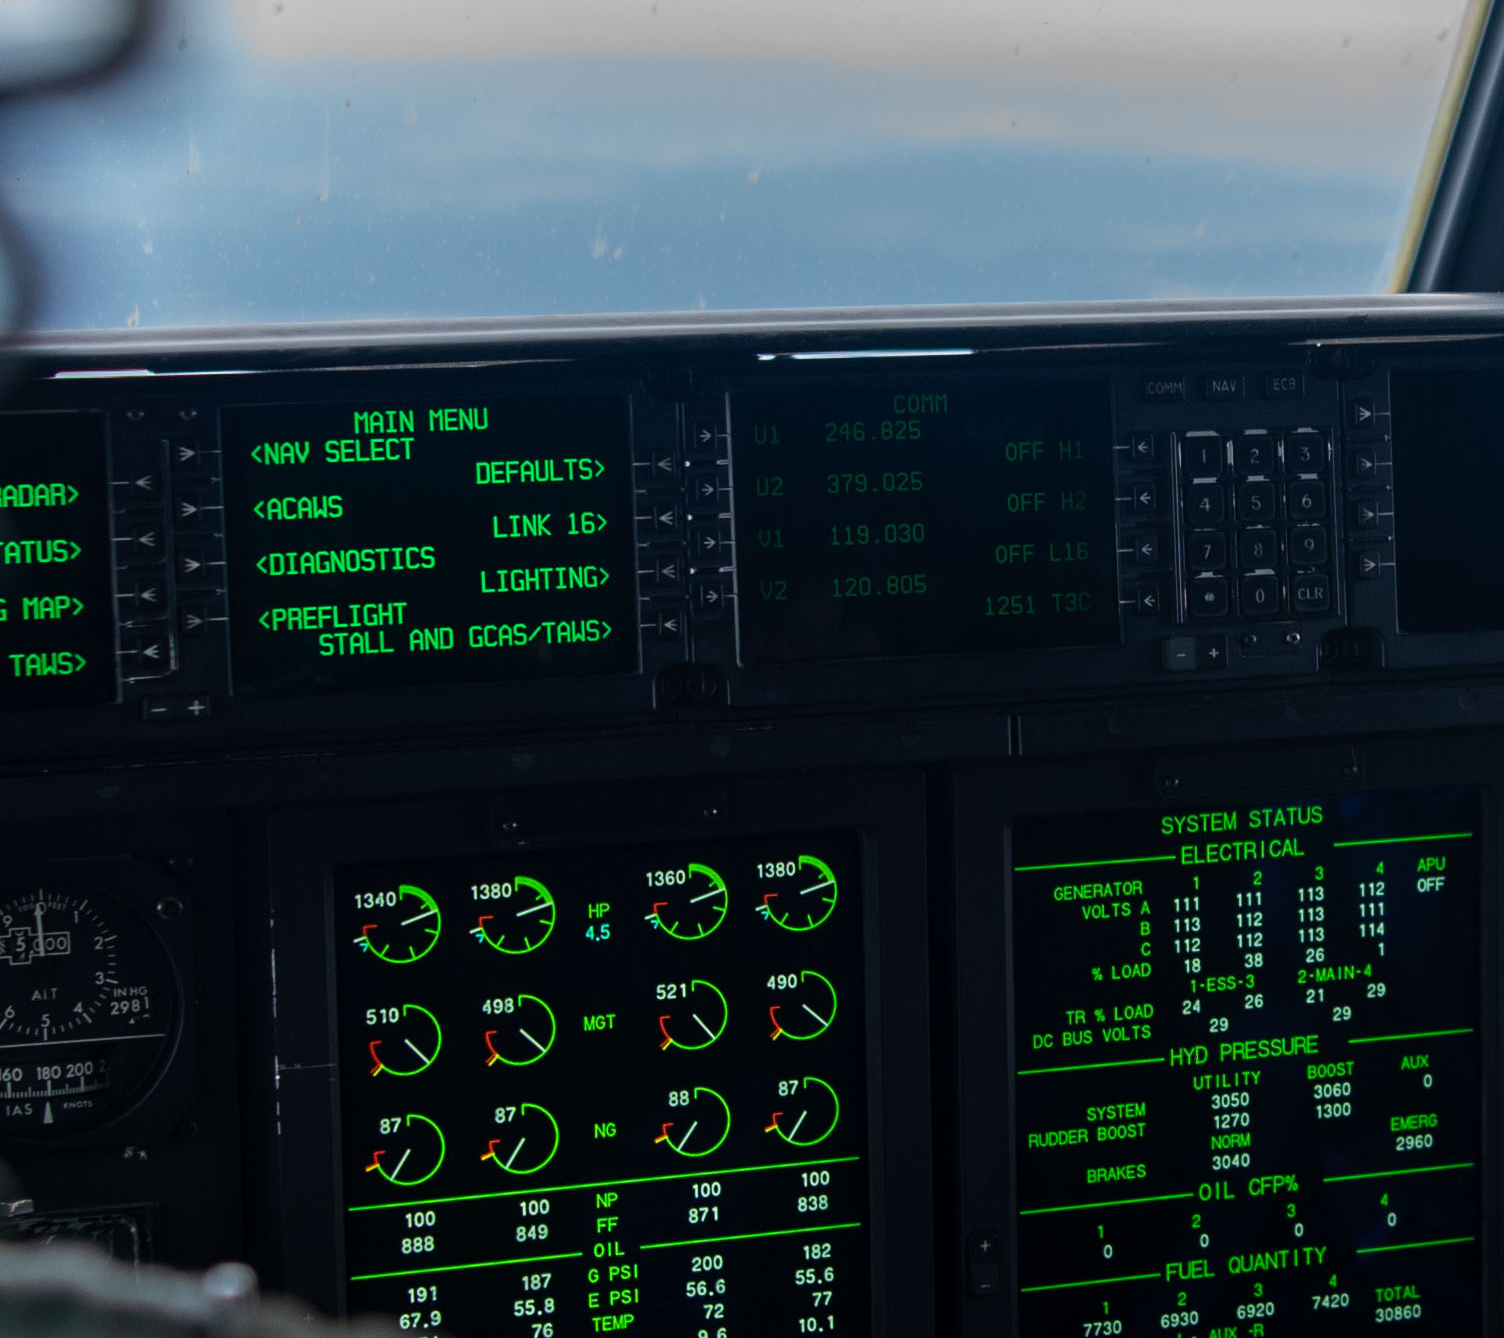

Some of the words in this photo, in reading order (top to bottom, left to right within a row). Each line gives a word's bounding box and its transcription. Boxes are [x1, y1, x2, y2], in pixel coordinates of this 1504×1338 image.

[1148, 378, 1185, 398] COMM
[1211, 378, 1237, 395] NAV
[1273, 377, 1296, 391] ECB
[354, 410, 414, 434] MAIN
[429, 408, 488, 431] MENU
[325, 438, 414, 462] SELECT
[493, 514, 551, 538] LINK
[1298, 584, 1324, 602] CLR
[319, 631, 394, 656] STALL
[410, 627, 453, 651] AND
[1162, 811, 1236, 834] SYSTEM
[1249, 806, 1323, 828] STATUS
[1181, 838, 1304, 865] ELECTRICAL
[1417, 857, 1445, 872] APU
[355, 892, 396, 908] 1340
[471, 883, 512, 900] 1380
[647, 870, 685, 886] 1360
[757, 862, 795, 878] 1380
[1054, 881, 1142, 901] GENERATOR
[589, 903, 610, 918] HP
[1082, 902, 1131, 919] VOLTS
[586, 924, 610, 941] 4.5
[1191, 974, 1254, 993] 1-ESS-3
[1298, 964, 1371, 984] 2-MAIN-4
[32, 988, 58, 1001] ALT
[130, 986, 147, 996] HG
[366, 1008, 399, 1025] 510
[483, 998, 514, 1014] 498
[657, 983, 686, 1000] 521
[767, 974, 797, 989] 490
[584, 1014, 616, 1031] MGT
[1171, 1046, 1208, 1066] HYD
[1220, 1035, 1318, 1061] PRESSURE
[37, 1066, 61, 1080] 180
[65, 1061, 94, 1077] 200
[1193, 1071, 1260, 1090] UTILITY
[1307, 1061, 1354, 1079] BOOST
[1401, 1055, 1429, 1069] AUX
[6, 1103, 32, 1116] IAS
[1087, 1102, 1145, 1121] SYSTEM
[1212, 1092, 1249, 1109] 3050
[1314, 1082, 1351, 1099] 3060
[595, 1122, 616, 1138] NG
[1029, 1129, 1088, 1148] RUDDER
[1097, 1123, 1145, 1141] BOOST
[1214, 1112, 1249, 1129] 1270
[1316, 1102, 1351, 1118] 1300
[1211, 1133, 1250, 1149] NORM
[1391, 1113, 1438, 1131] EMERG
[1087, 1164, 1146, 1183] BRAKES
[1213, 1153, 1250, 1170] 3040
[1396, 1134, 1433, 1151] 2960
[1199, 1181, 1235, 1201] OIL
[1248, 1175, 1298, 1196] CFP%
[594, 1242, 624, 1258] OIL
[1166, 1260, 1215, 1281] FUEL
[1229, 1246, 1326, 1274] QUANTITY
[1376, 1285, 1420, 1302] TOTAL
[592, 1314, 634, 1332] TEMP
[1083, 1320, 1122, 1337] 7730
[1161, 1311, 1198, 1328] 6930
[1237, 1302, 1274, 1319] 6920
[1312, 1293, 1349, 1309] 7420
[1376, 1304, 1421, 1323] 30860
